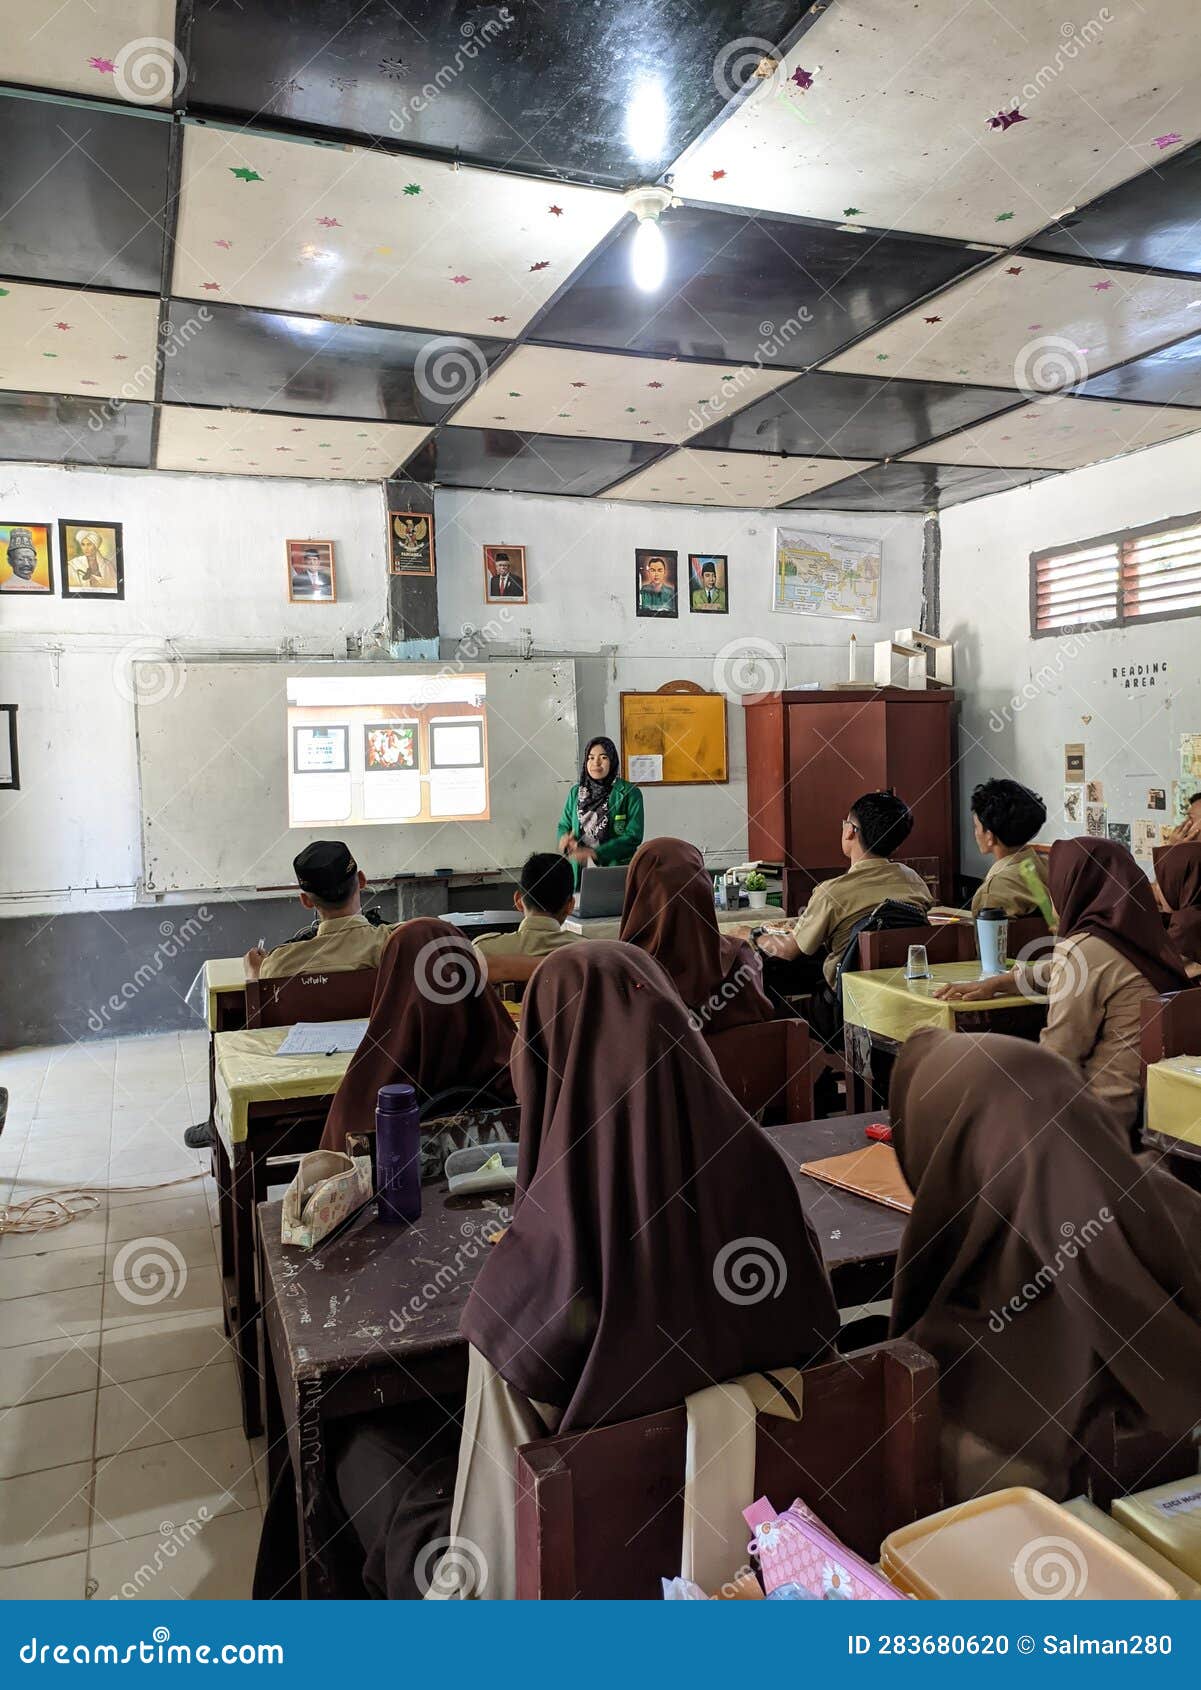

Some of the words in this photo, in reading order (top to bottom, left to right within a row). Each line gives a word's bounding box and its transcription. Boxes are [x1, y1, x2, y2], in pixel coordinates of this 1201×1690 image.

[1112, 662, 1168, 679] READING
[1124, 676, 1155, 689] AREA
[302, 1379, 322, 1465] WULAN
